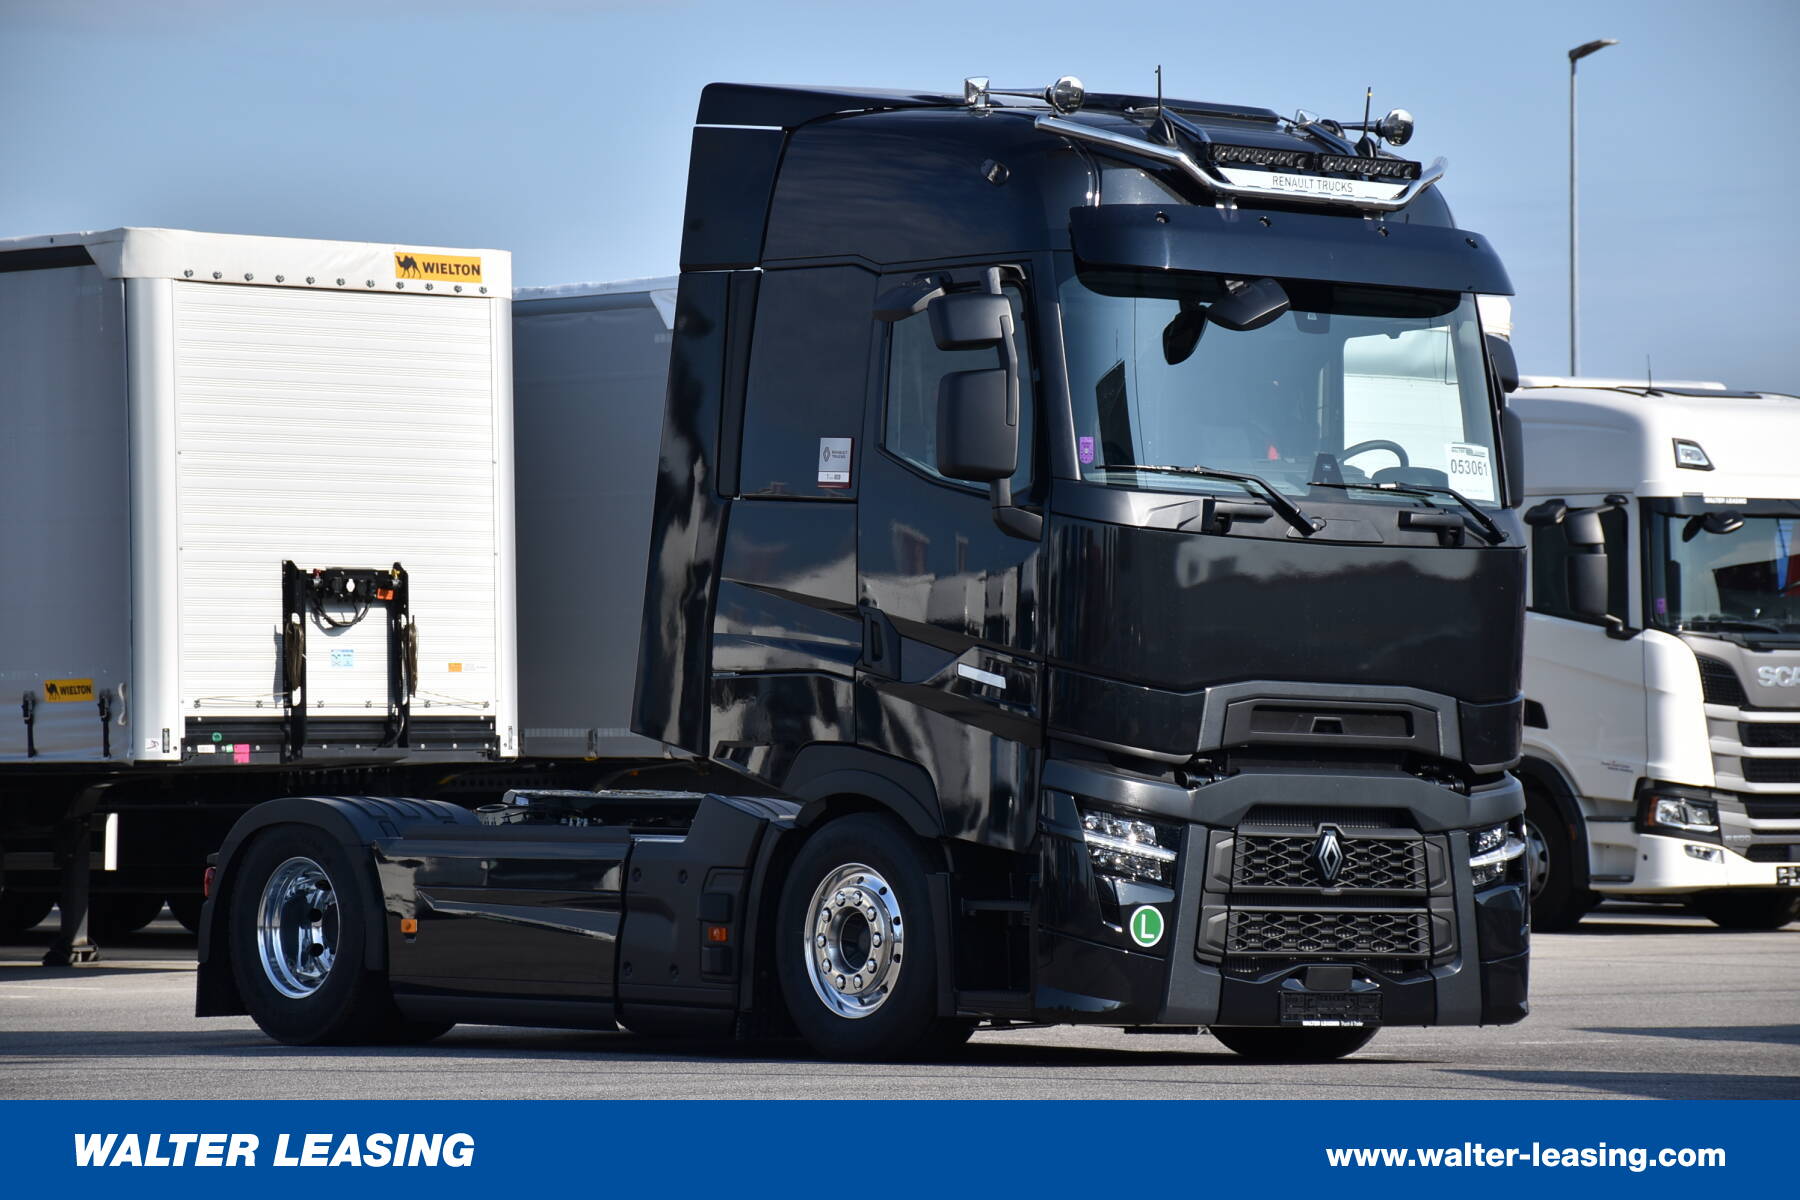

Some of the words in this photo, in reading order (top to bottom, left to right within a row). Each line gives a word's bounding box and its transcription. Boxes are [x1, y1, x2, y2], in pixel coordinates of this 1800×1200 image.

[1272, 175, 1314, 189] RENAULT
[1316, 179, 1353, 193] TRUCKS
[422, 261, 481, 276] WIELTON
[1450, 459, 1488, 477] 053061
[59, 684, 92, 696] WIELTON
[1141, 913, 1155, 939] L
